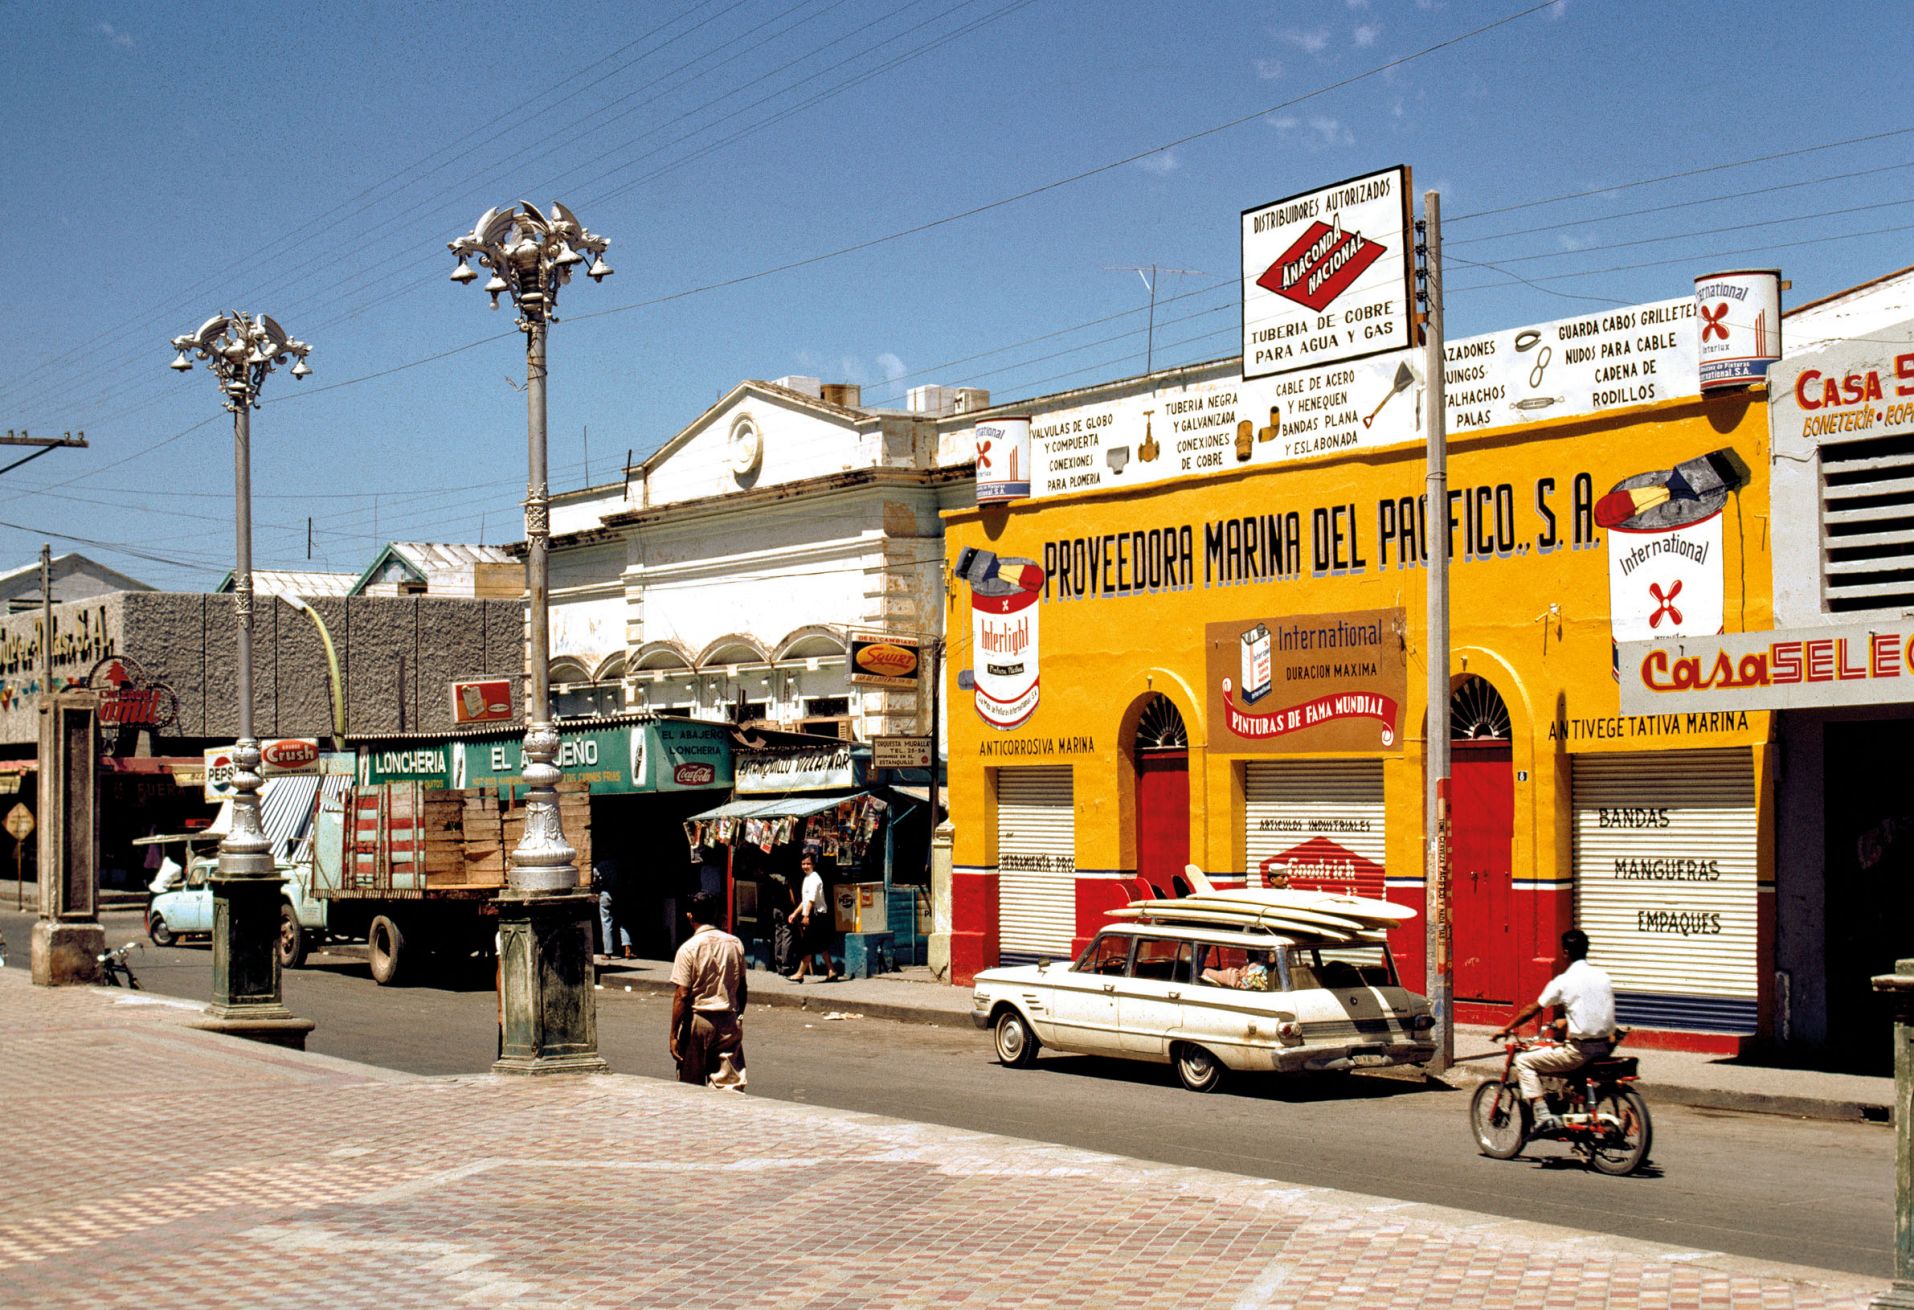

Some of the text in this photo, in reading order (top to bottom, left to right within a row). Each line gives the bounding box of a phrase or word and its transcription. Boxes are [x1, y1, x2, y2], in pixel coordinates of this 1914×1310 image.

[1254, 177, 1390, 234] DISTRIBUIDORES AUTORIZADOS
[1281, 212, 1342, 291] ANACONDA
[1308, 230, 1365, 296] NACIONAL
[1252, 301, 1394, 344] TUBERIA DE COBRE
[1558, 320, 1600, 341] GUARDA
[1602, 312, 1636, 333] CABOS
[1255, 322, 1394, 364] PARA AGUA Y GAS
[1565, 332, 1677, 365] NUDOS PARA CABLE
[1276, 369, 1355, 397] CABLE DE ACERO
[1443, 364, 1485, 384] UINGOS
[1595, 359, 1657, 383] CADENA DE
[1287, 391, 1347, 414] Y HENEQUEN
[1593, 384, 1655, 406] RODILLOS
[1795, 369, 1883, 411] CASA
[1166, 393, 1238, 416] TUBERIA NEGRA
[1884, 401, 1914, 427] ROP
[1032, 413, 1113, 440] VALVULAS DE GLOBO
[1173, 411, 1236, 433] Y GALVANIZADA
[1282, 409, 1359, 437] BANDAS PLANA
[1456, 410, 1491, 428] PALAS
[1044, 434, 1099, 454] Y COMPUERTA
[1176, 433, 1230, 454] CONEXIONES
[1285, 430, 1358, 456] Y ESLABONADA
[1049, 454, 1093, 472] CONEXIONES
[1181, 452, 1223, 470] DE COBRE
[1047, 472, 1101, 491] PARA PLOMERIA
[1043, 524, 1193, 603] PROVEEDORA
[1204, 511, 1300, 588] MARINA
[1312, 503, 1366, 578] DEL
[1619, 532, 1709, 576] International
[981, 616, 1029, 656] Interlight
[1278, 618, 1382, 651] International
[1286, 664, 1331, 681] DURACION
[1333, 662, 1378, 678] MAXIMA
[1641, 647, 1771, 693] Casa
[100, 689, 161, 724] amil
[1232, 695, 1384, 735] PINTURAS DE FAMA MUNDIAL
[662, 730, 674, 740] EL
[1686, 711, 1749, 734] MARINA
[266, 744, 314, 762] Crush
[669, 745, 721, 755] LONCHERIA
[979, 736, 1095, 756] ANTICORROSIVA MARINA
[375, 751, 446, 774] LONCHERIA
[491, 747, 512, 770] EL
[827, 753, 850, 771] MAR
[1260, 819, 1371, 832] ARTICULOS INDUSTRIALES
[1599, 808, 1670, 828] BANDAS
[1615, 858, 1721, 882] MANGUERAS
[1637, 910, 1721, 937] EMPAQUES
